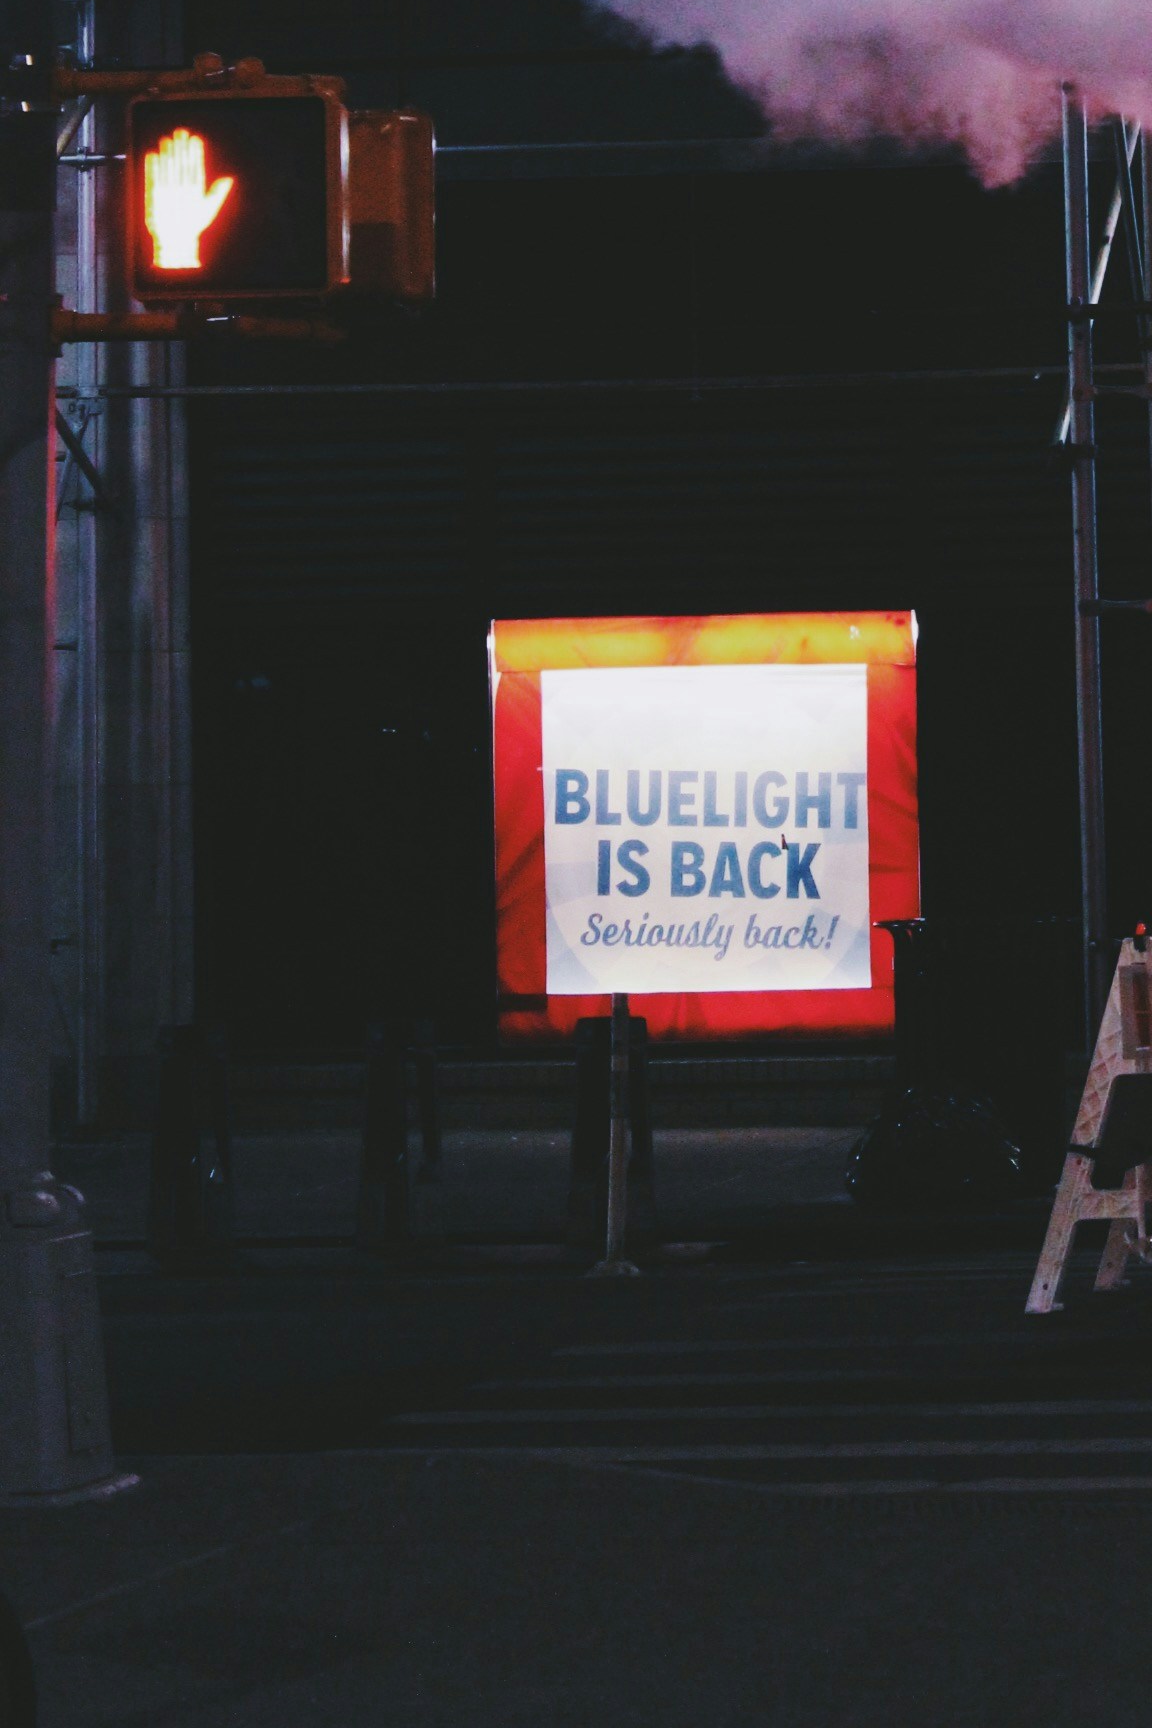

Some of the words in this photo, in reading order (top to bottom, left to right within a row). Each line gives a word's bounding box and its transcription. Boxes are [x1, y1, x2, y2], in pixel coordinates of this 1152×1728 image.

[554, 768, 867, 830] BLUELIGHT
[596, 839, 650, 897] IS
[670, 841, 822, 900] BACK
[580, 912, 735, 961] Seriously
[744, 913, 840, 951] back!
